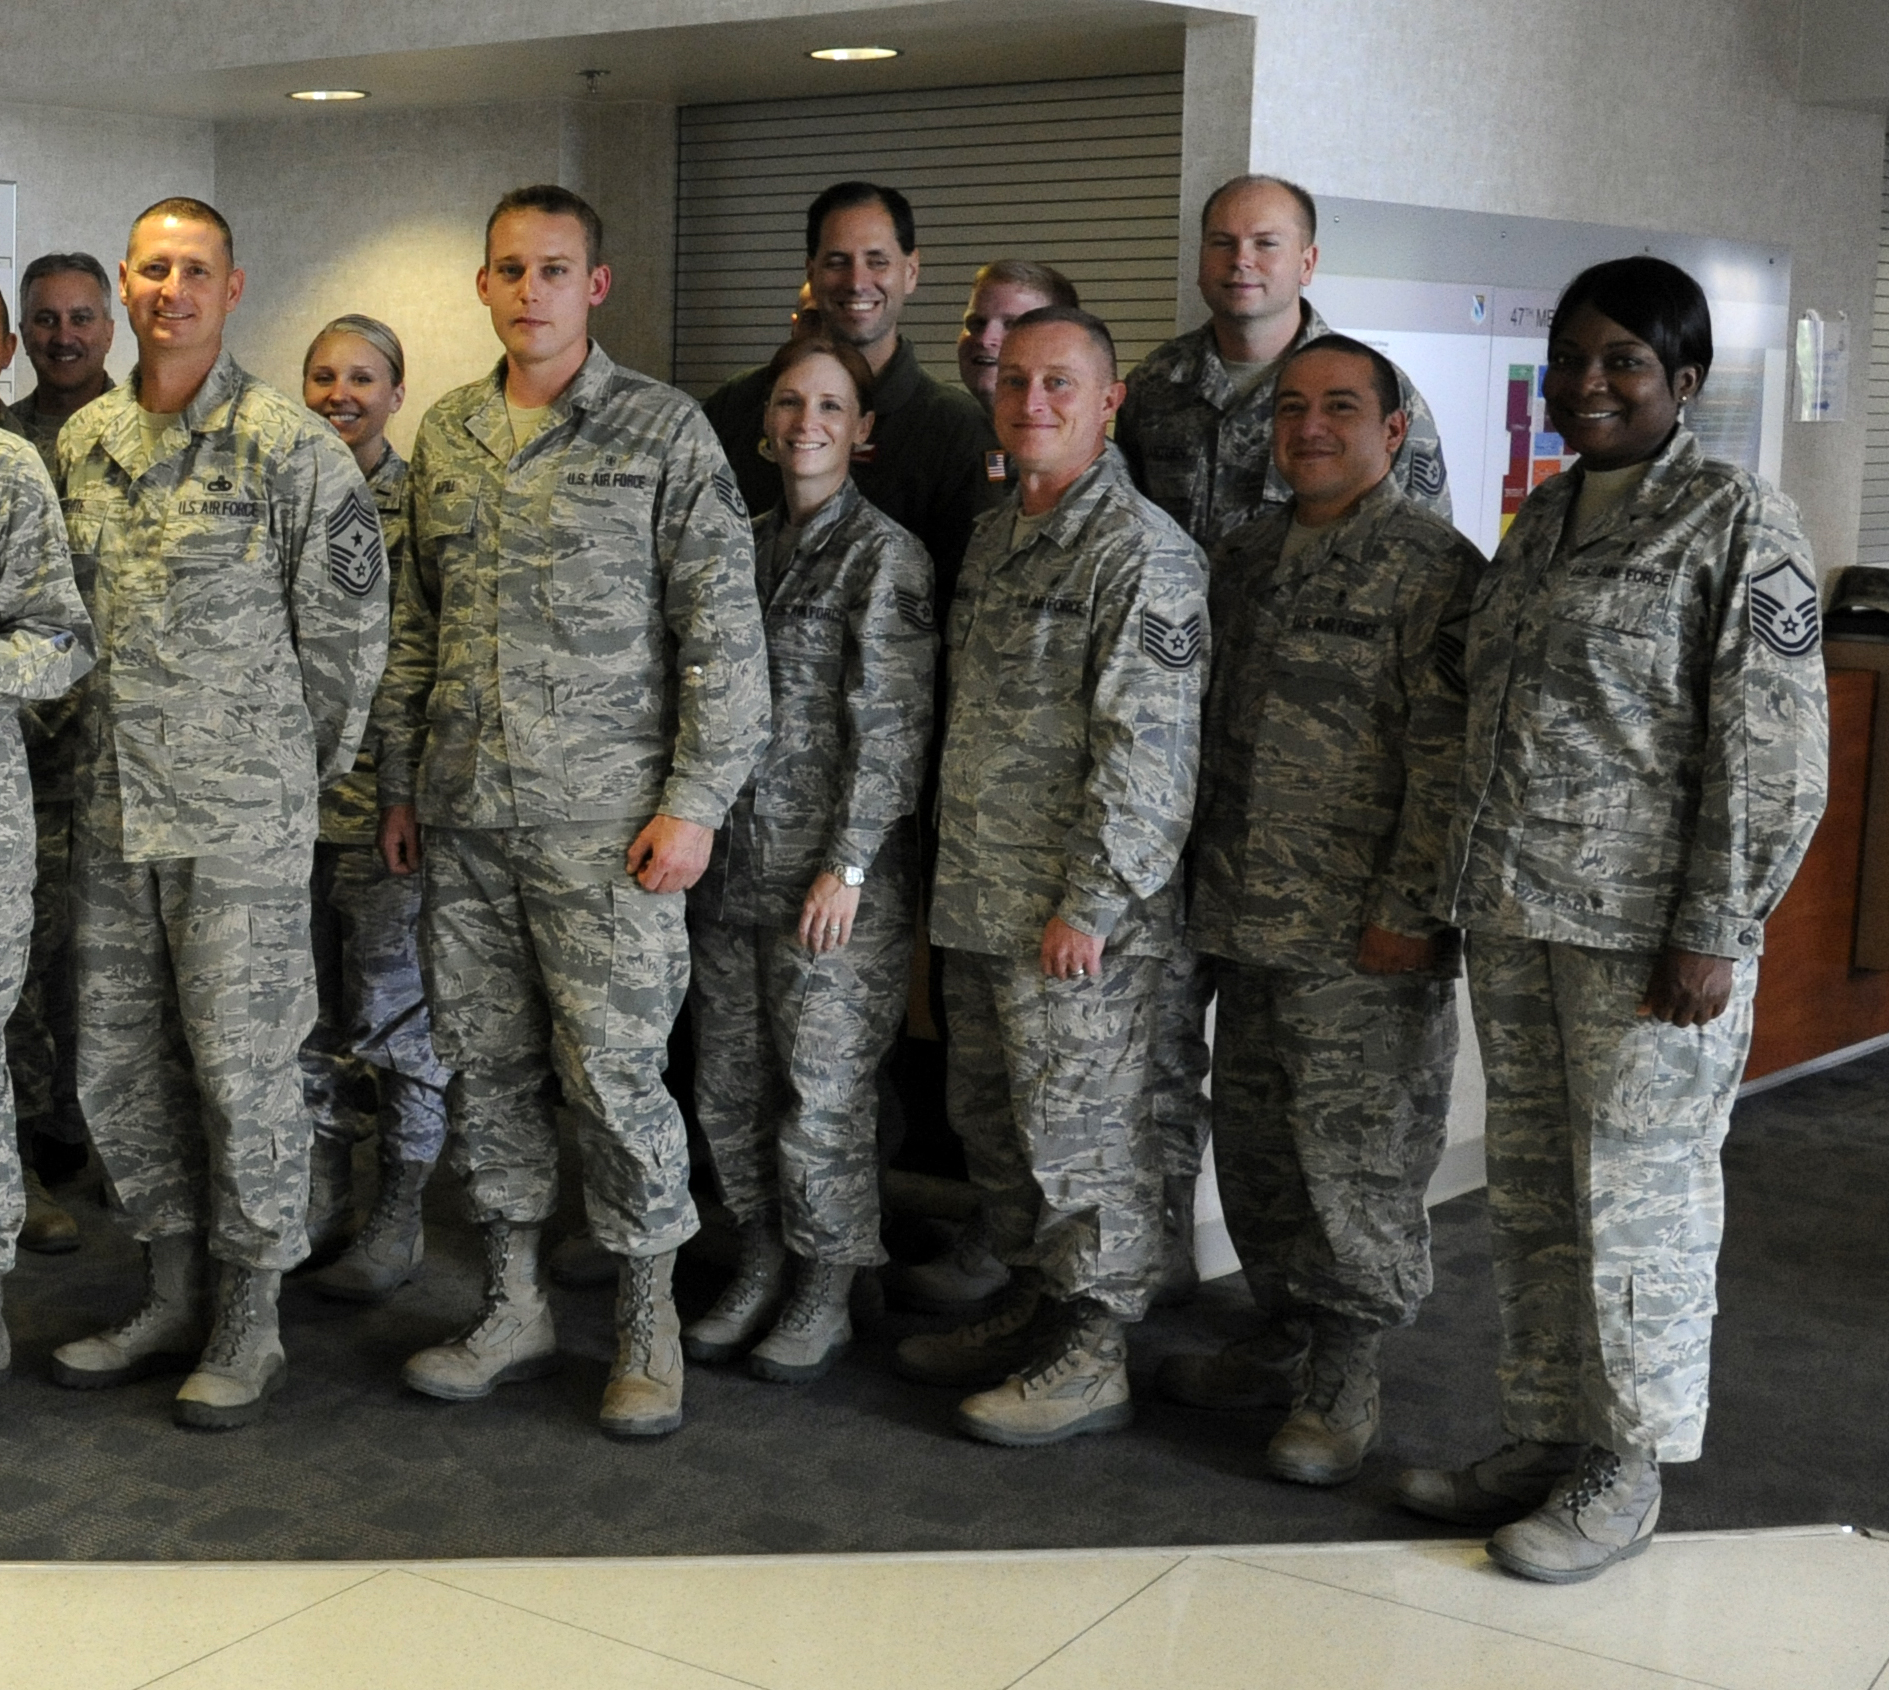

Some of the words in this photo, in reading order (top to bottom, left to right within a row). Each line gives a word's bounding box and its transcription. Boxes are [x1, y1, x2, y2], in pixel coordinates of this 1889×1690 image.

[591, 473, 611, 487] AIR
[613, 473, 646, 489] FORCE
[200, 501, 221, 516] AIR
[222, 501, 260, 518] FORCE
[1624, 568, 1672, 588] FORCE
